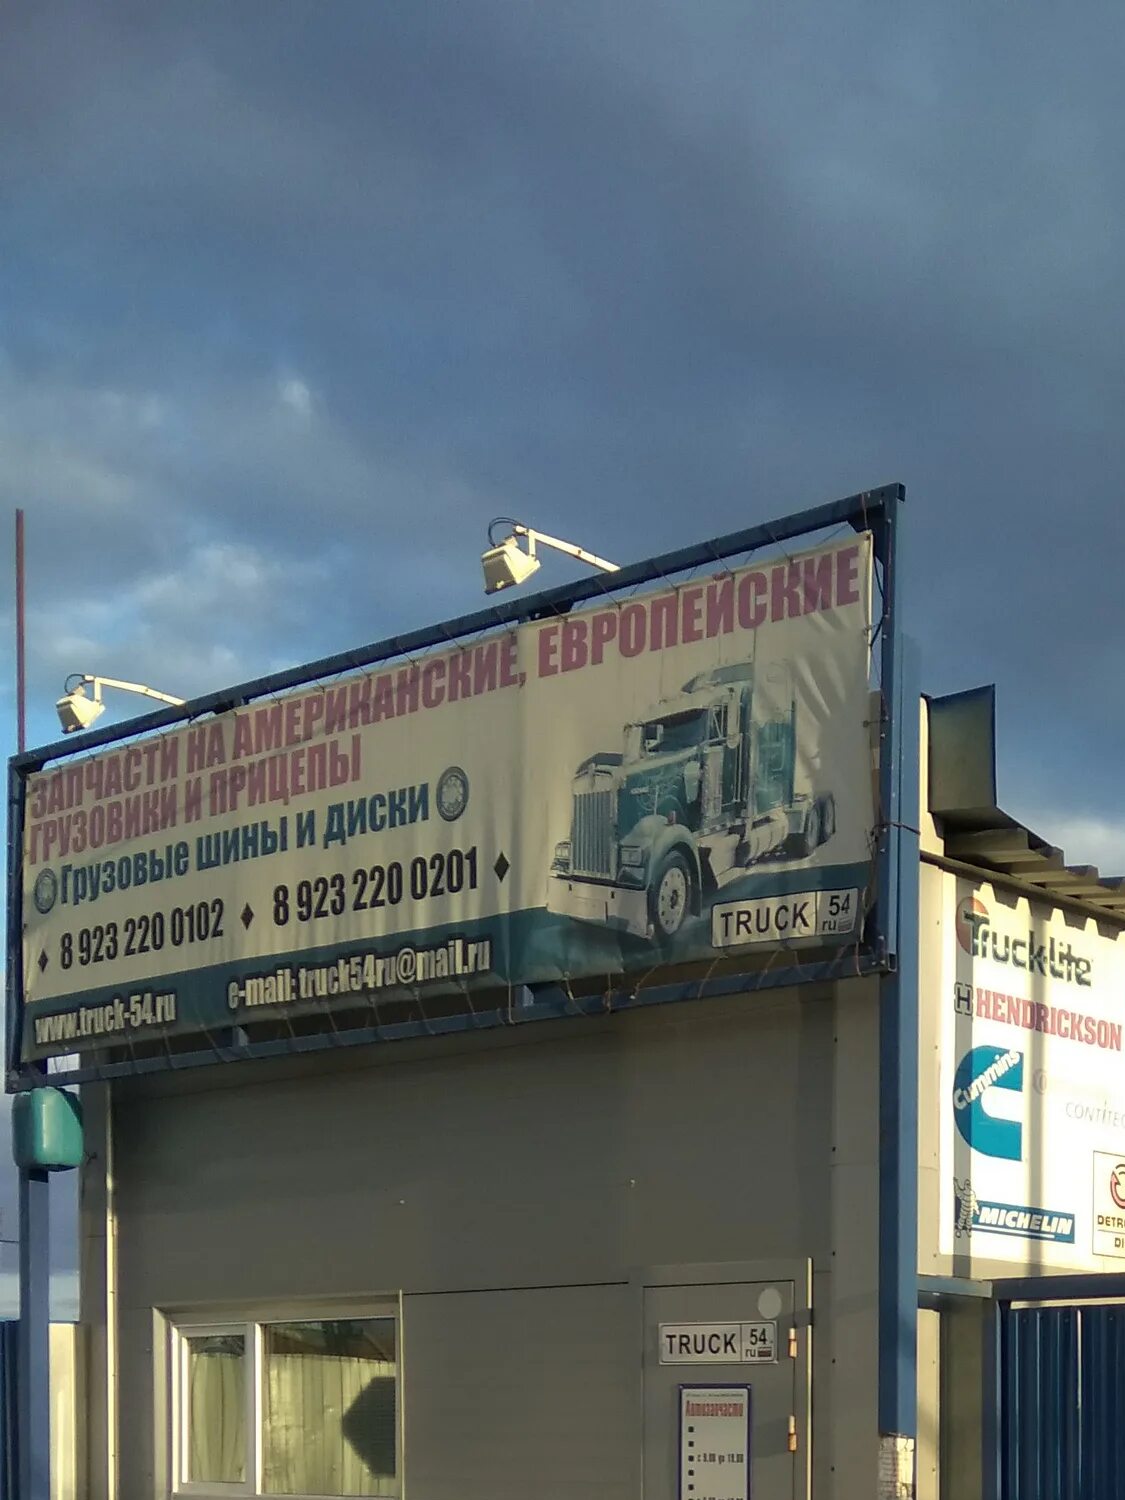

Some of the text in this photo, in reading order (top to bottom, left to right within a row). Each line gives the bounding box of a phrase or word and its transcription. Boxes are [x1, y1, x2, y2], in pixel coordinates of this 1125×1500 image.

[30, 545, 860, 819] ЗАПЧАСТИ НА АМЕРИКАНСКИЕ, ЕВРОПЕЙСКИЕ
[29, 734, 361, 866] ГРУЗОВИКИ И ПРИЦЕПЫ
[60, 841, 189, 906] Грузовые
[273, 845, 478, 926] 8 923 220 0201
[60, 898, 225, 970] 8 923 220 0102
[720, 893, 851, 938] TRUCK 54
[822, 919, 837, 931] ru
[228, 939, 491, 1010] e-mail: truck54ru@mail.ru
[35, 993, 177, 1044] www.truck-54.ru
[975, 987, 1123, 1051] HENDRICKSON
[953, 1049, 1020, 1110] Cummins
[977, 1205, 1073, 1235] MICHELIN
[665, 1328, 768, 1354] TRUCK 54
[745, 1349, 756, 1358] ru
